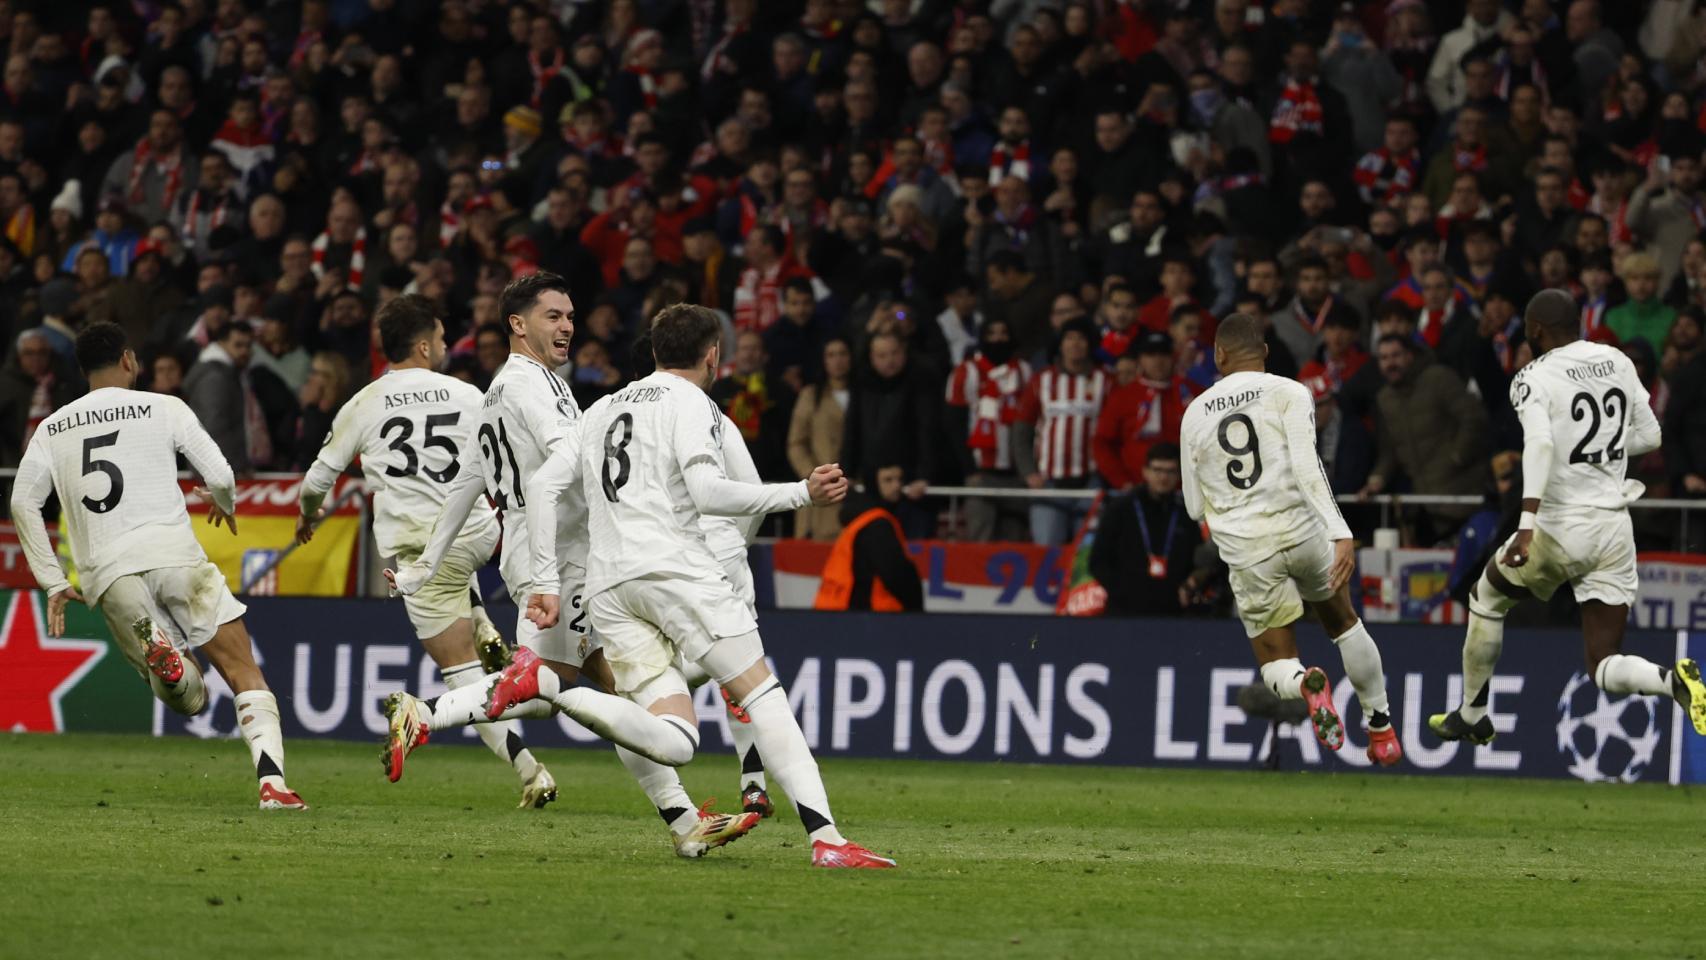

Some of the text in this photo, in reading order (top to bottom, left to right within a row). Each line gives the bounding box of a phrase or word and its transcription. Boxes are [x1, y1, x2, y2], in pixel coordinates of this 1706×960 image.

[47, 405, 151, 437] BELLINGHAM
[384, 388, 450, 410] ASENCIO
[1569, 387, 1627, 465] 22
[81, 429, 124, 514] 5
[379, 411, 461, 484] 35
[478, 416, 526, 511] 21
[601, 412, 633, 503] 8
[1217, 412, 1263, 490] 9
[569, 594, 594, 635] 2
[557, 656, 1113, 760] AMPIONS
